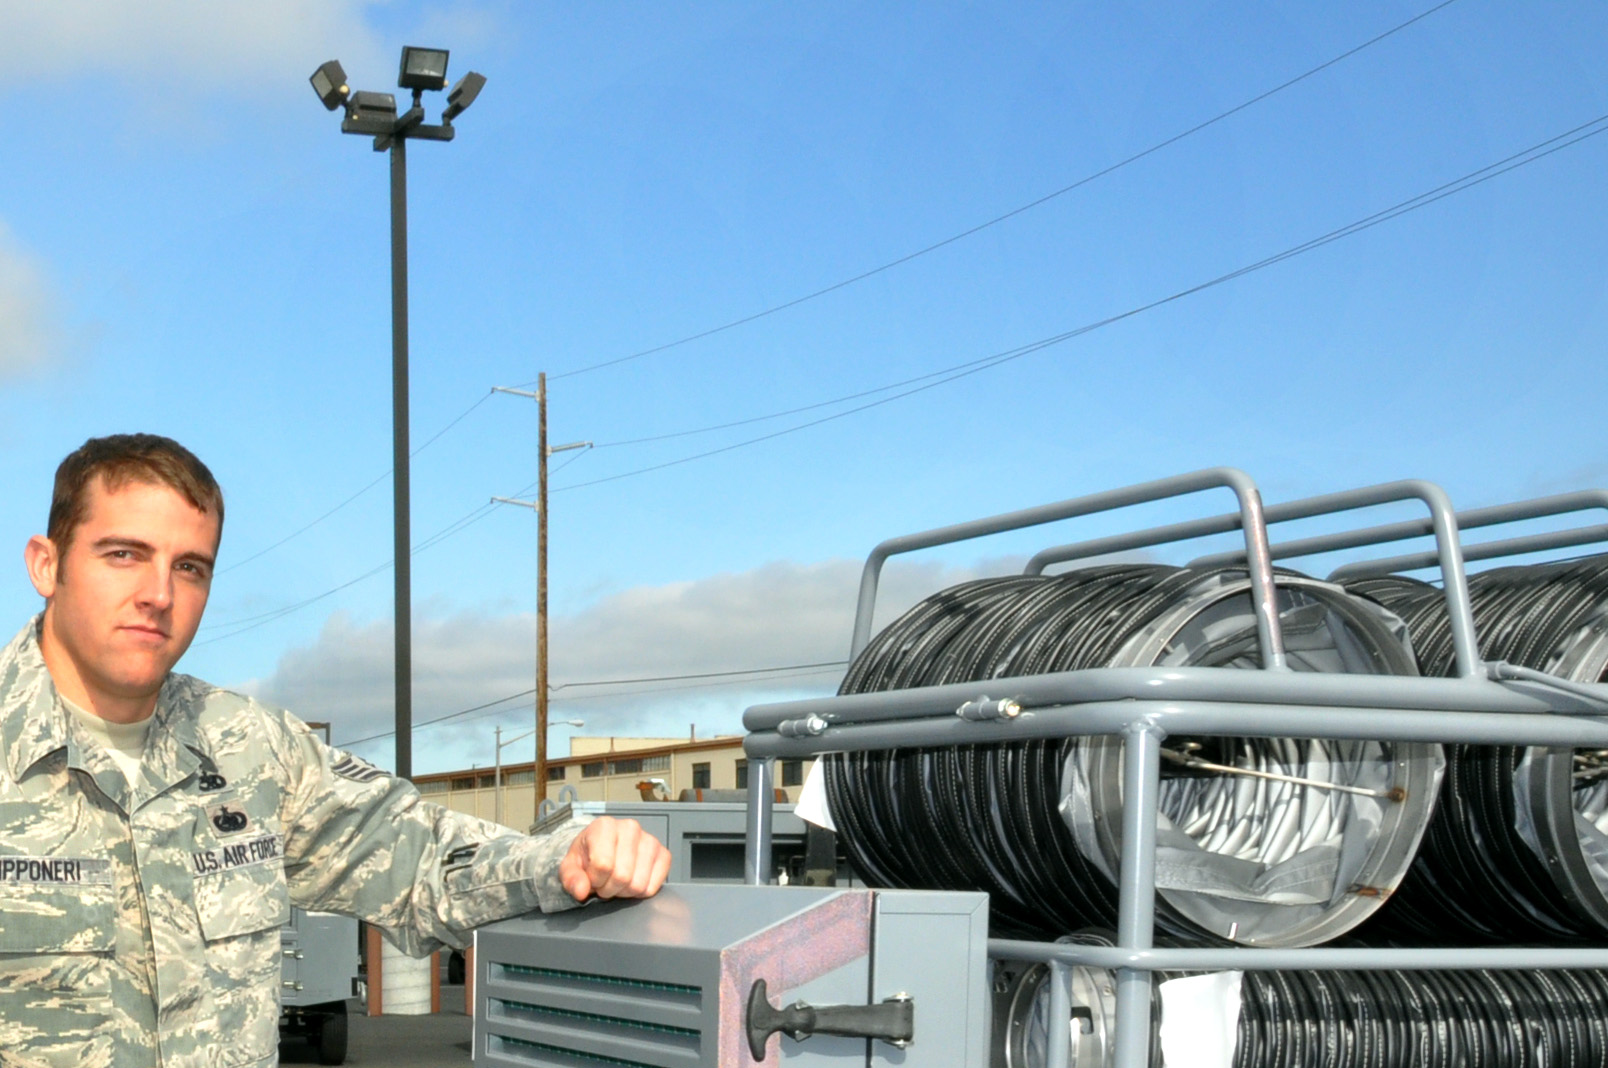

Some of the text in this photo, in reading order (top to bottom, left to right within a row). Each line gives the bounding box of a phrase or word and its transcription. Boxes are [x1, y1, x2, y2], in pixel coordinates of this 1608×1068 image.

[193, 837, 279, 873] U.S. AIR FORCE
